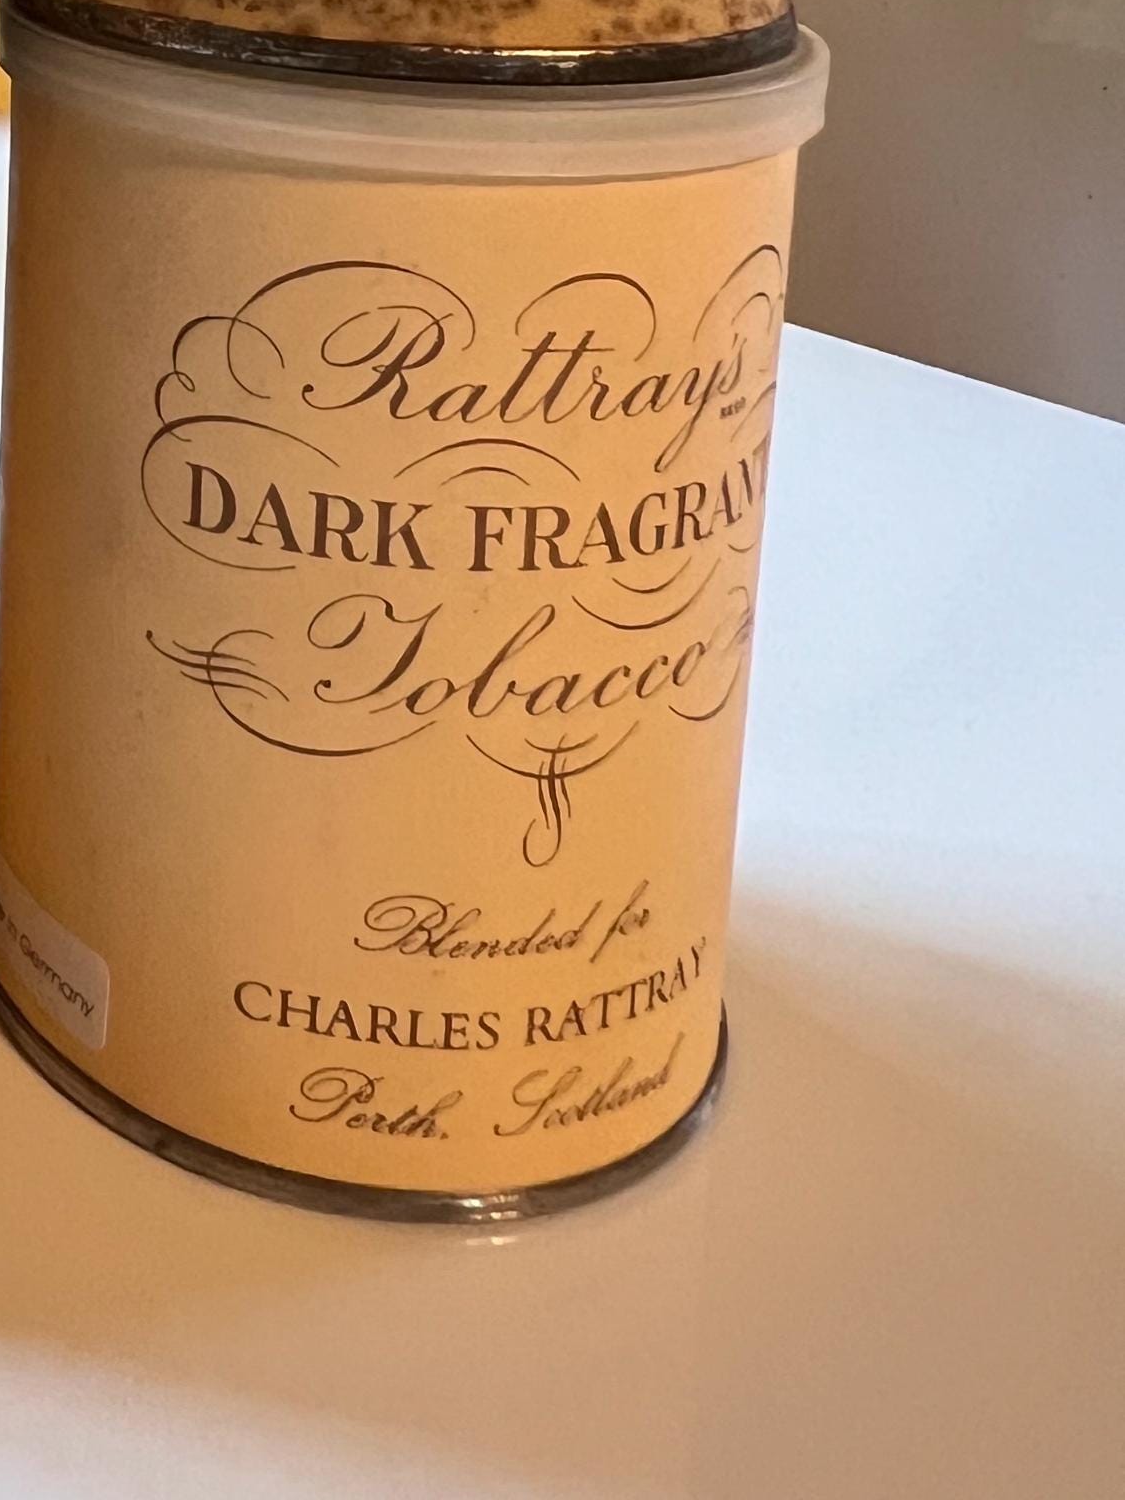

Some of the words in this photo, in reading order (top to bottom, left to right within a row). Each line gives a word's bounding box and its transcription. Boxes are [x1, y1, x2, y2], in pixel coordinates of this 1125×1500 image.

[302, 305, 748, 473] Rattray's
[183, 461, 434, 570] DARK
[307, 594, 713, 717] Tobacco
[19, 933, 95, 1017] Germany
[353, 895, 603, 959] Blended
[589, 878, 651, 963] for
[233, 980, 501, 1050] CHARLES
[525, 936, 708, 1047] RATTRAY
[493, 1033, 686, 1137] Scotland
